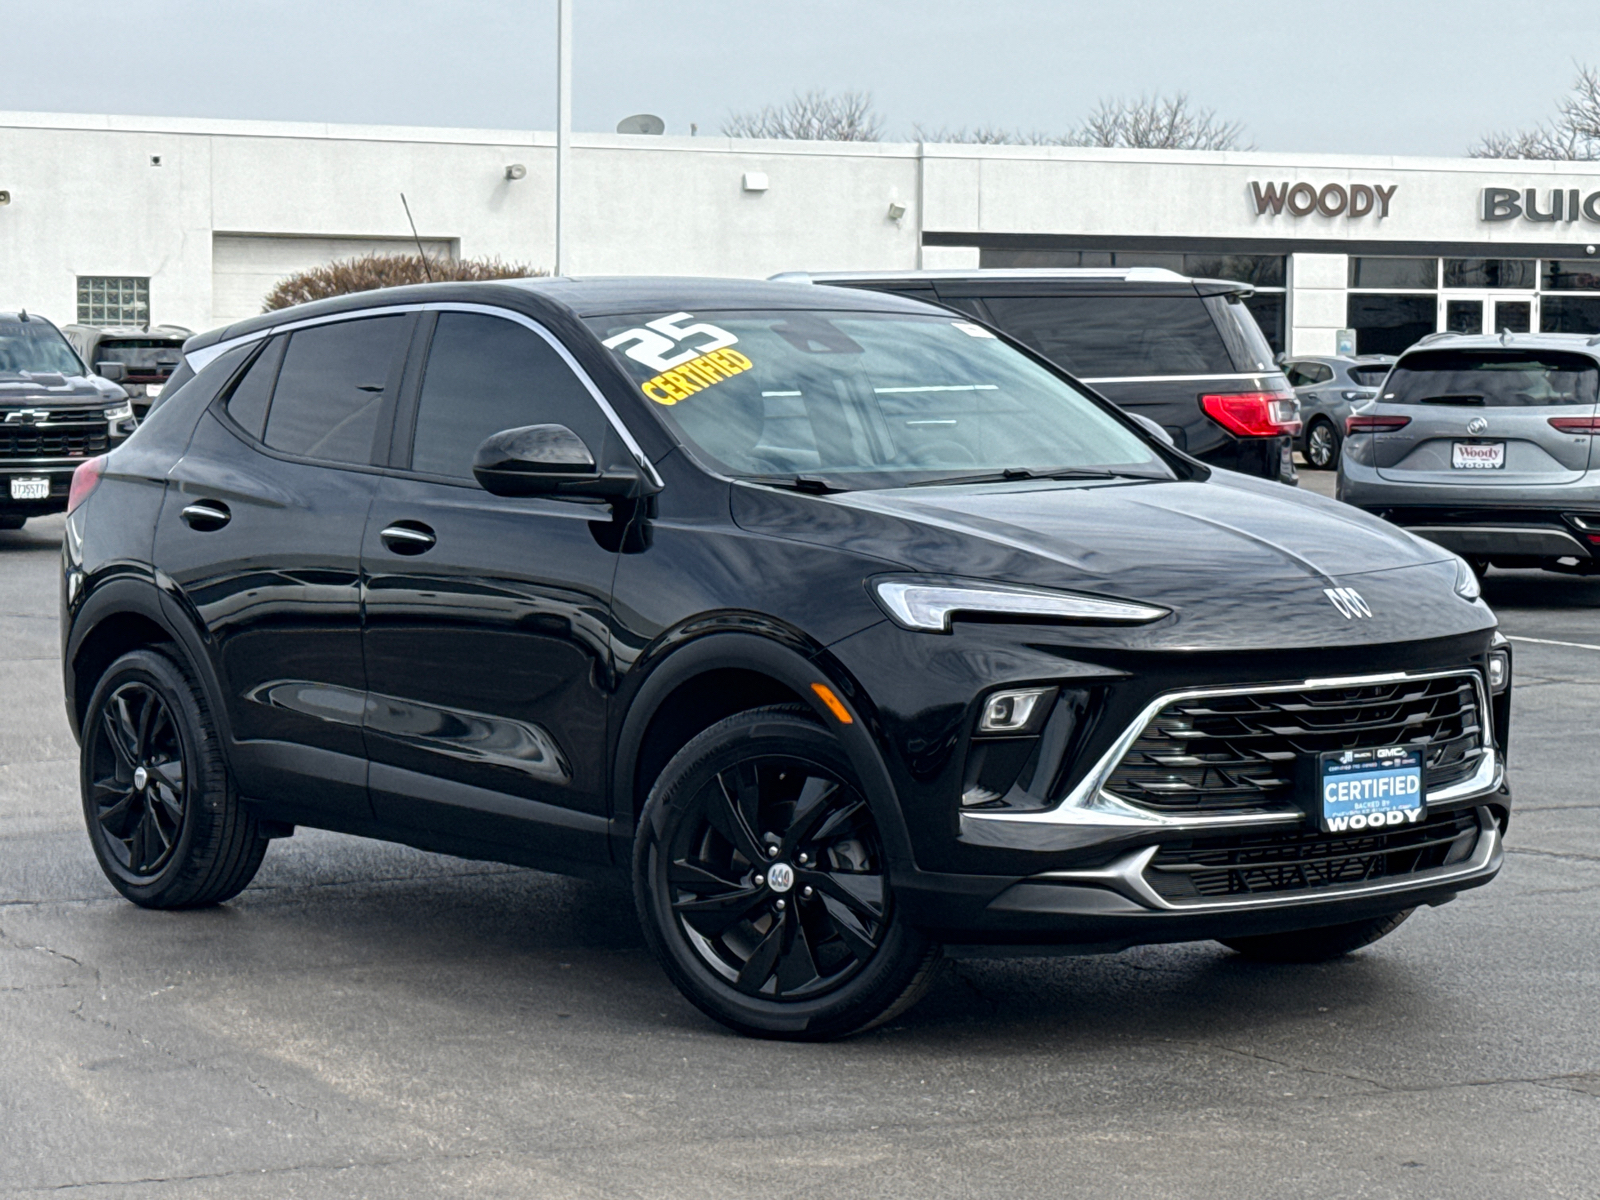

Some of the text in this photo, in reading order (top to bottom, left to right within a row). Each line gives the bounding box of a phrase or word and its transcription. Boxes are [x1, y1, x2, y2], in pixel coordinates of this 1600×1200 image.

[1248, 181, 1398, 218] WOODY
[601, 312, 739, 372] 25
[641, 348, 753, 406] CERTIFIED
[1458, 447, 1500, 460] Woody
[1377, 747, 1405, 758] GMC
[1325, 775, 1420, 803] CERTIFIED
[1354, 801, 1380, 810] BACKED
[1327, 807, 1422, 832] WOODY
